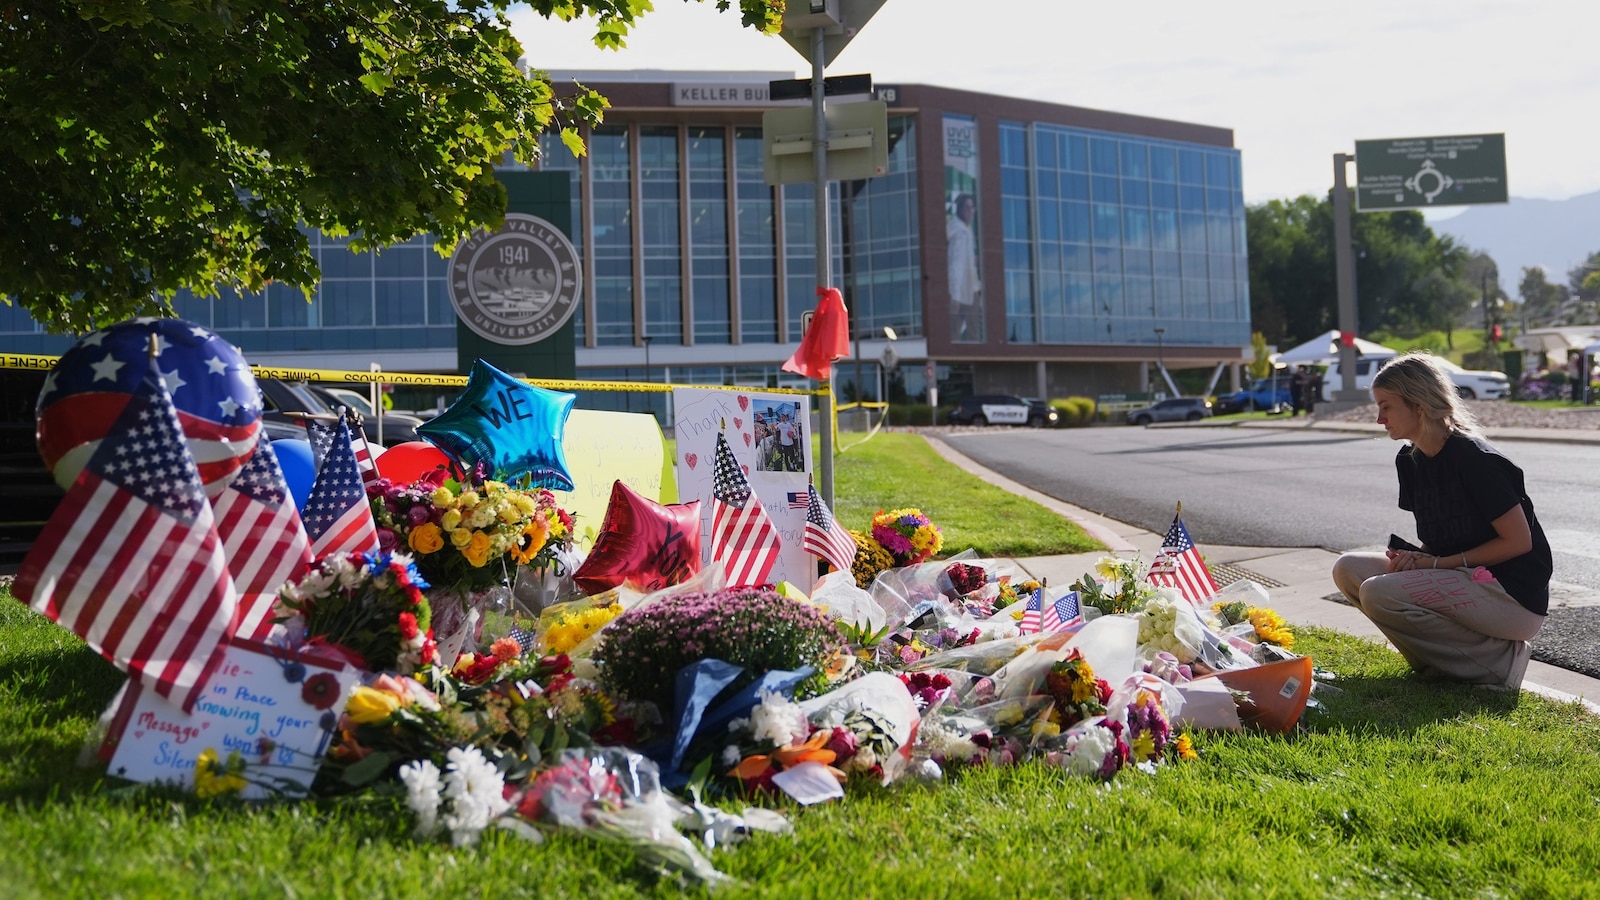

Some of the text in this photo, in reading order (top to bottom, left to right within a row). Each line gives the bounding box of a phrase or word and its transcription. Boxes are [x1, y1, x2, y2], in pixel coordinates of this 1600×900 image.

[681, 88, 769, 101] KELLER BUI
[877, 89, 896, 102] KB
[508, 221, 563, 250] VALLEY
[498, 245, 529, 265] 1941
[474, 313, 557, 337] UNIVERSITY
[9, 357, 58, 368] SCENE
[253, 369, 320, 381] CRIME SCE
[470, 385, 533, 430] WE
[675, 398, 733, 441] Thank
[762, 501, 789, 517] eath,
[779, 525, 803, 548] tory
[1428, 568, 1479, 610] LOVE
[213, 682, 277, 707] in Peace
[194, 694, 314, 737] Knowing your
[154, 741, 196, 769] Silen
